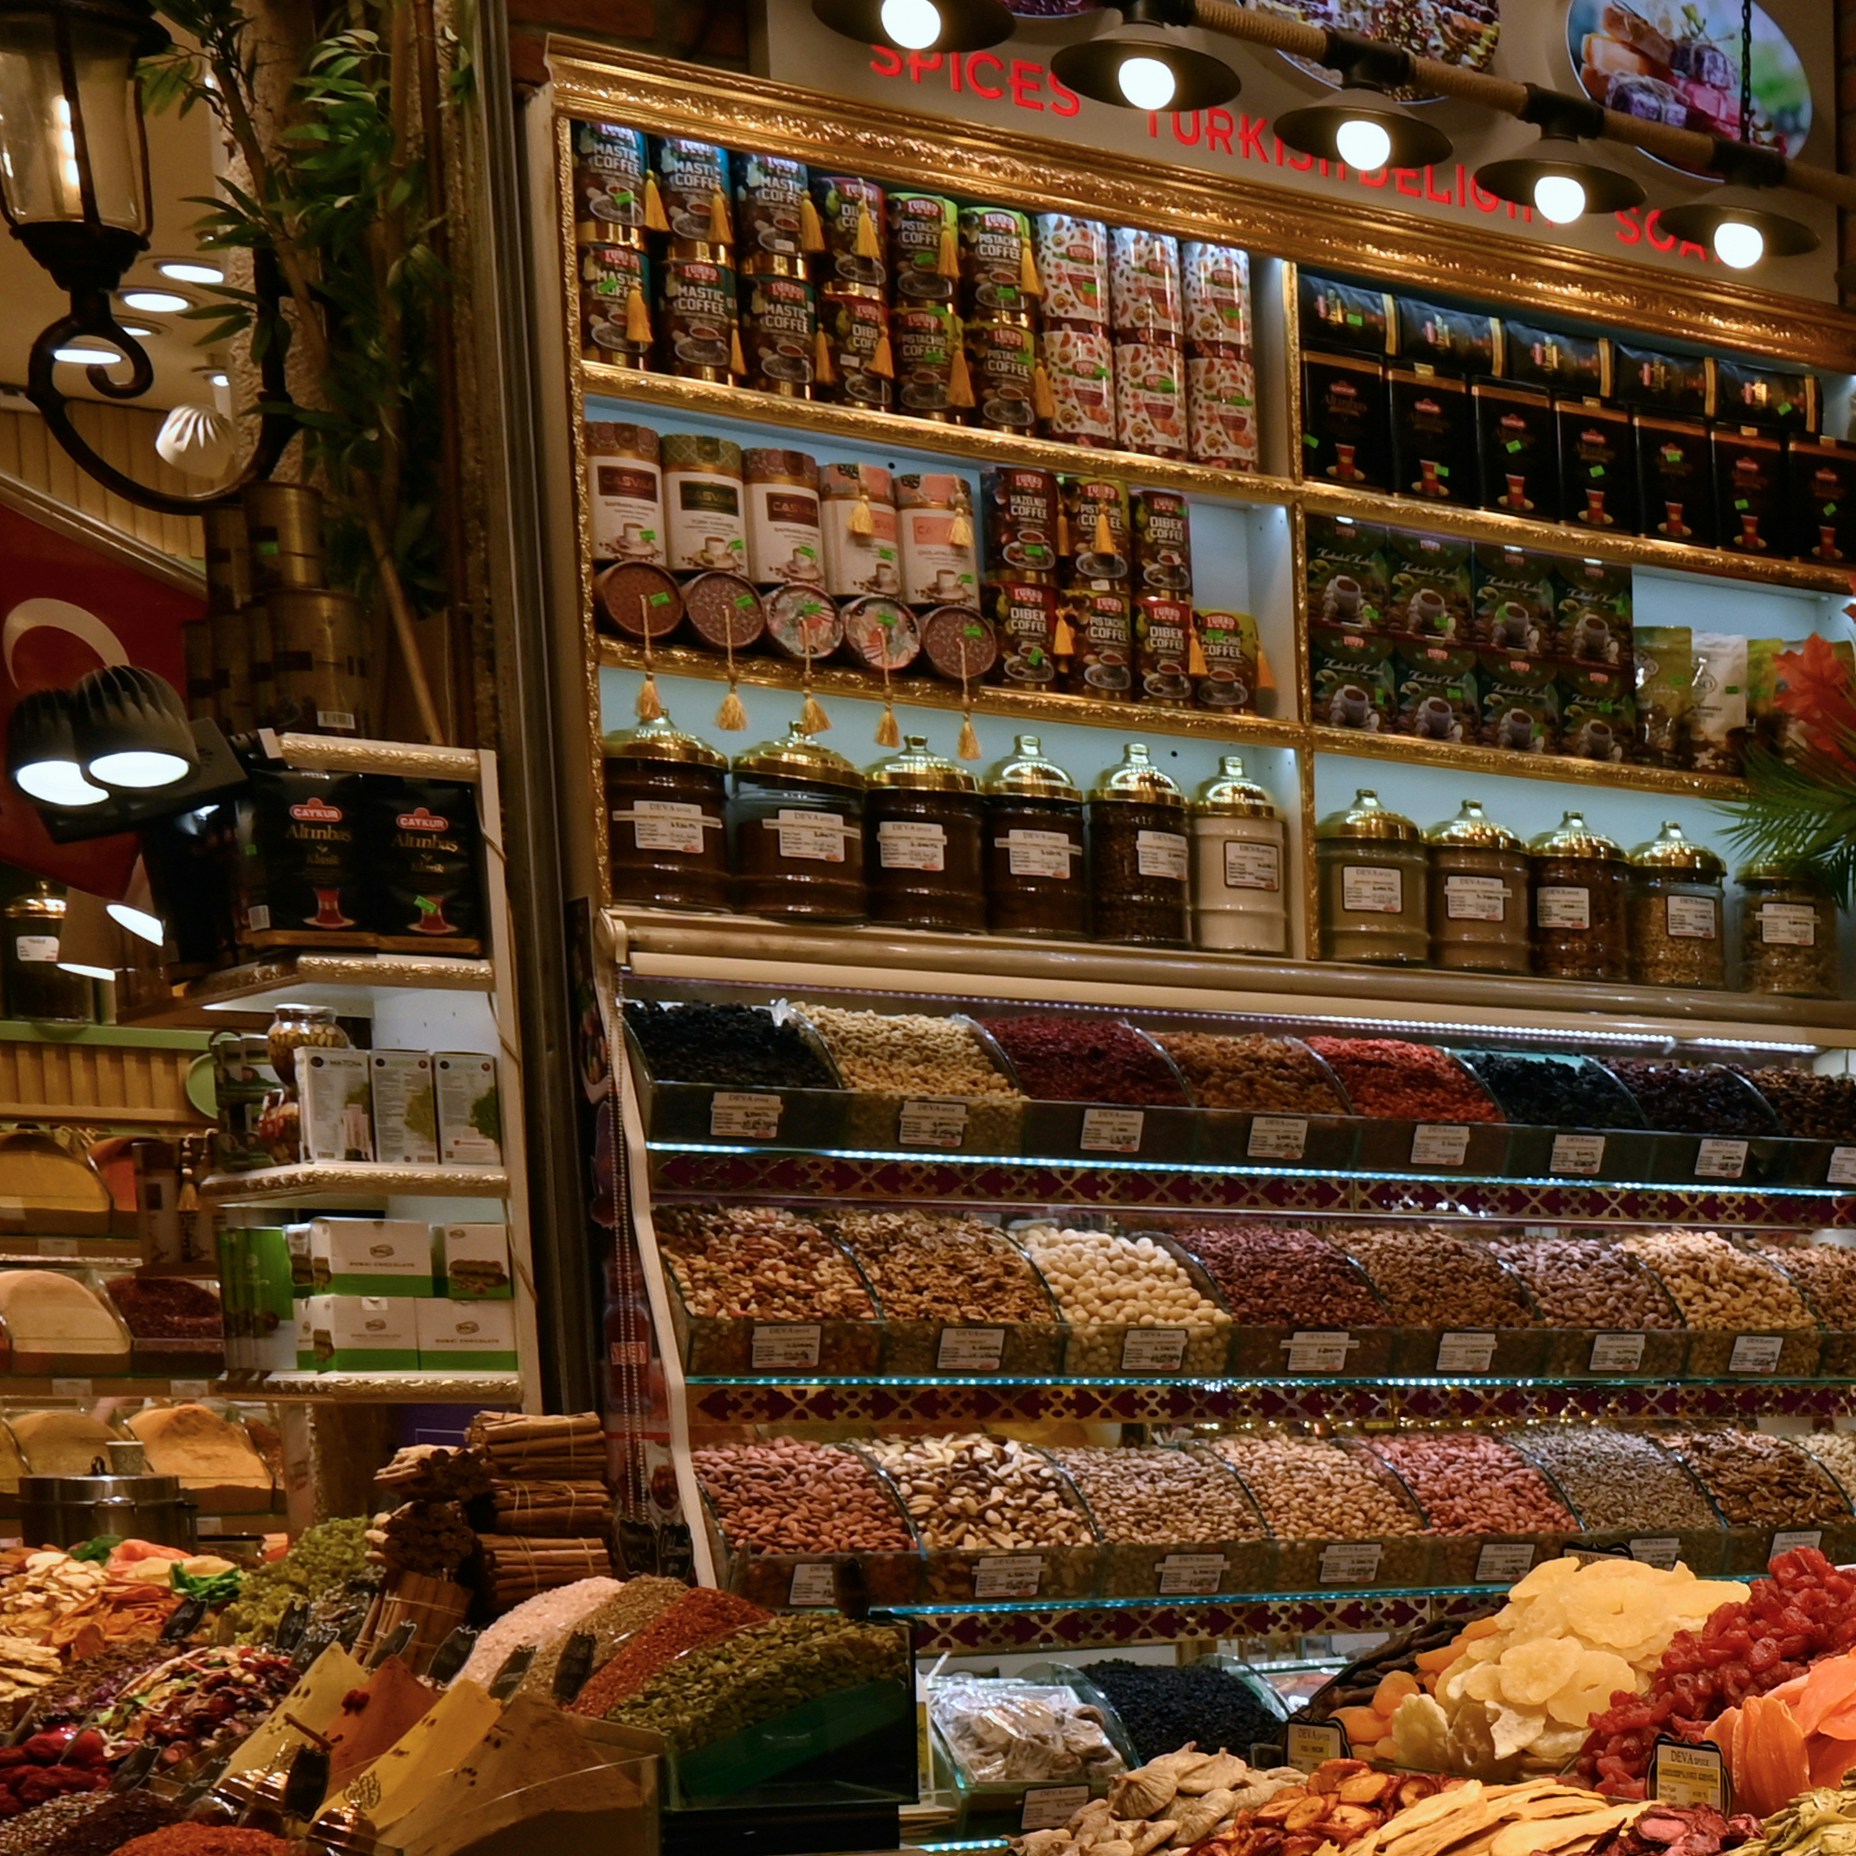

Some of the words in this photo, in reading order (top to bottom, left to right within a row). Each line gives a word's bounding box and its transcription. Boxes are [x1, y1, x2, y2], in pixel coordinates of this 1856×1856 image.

[869, 44, 1081, 117] SPICES
[593, 154, 640, 175] COFFEE
[979, 244, 1021, 261] COFFEE
[676, 285, 724, 304] MASTIC
[677, 297, 725, 316] COFFEE
[987, 361, 1029, 377] COFFEE
[1011, 504, 1048, 520] COFFEE
[1150, 516, 1184, 530] DIBEK
[1150, 526, 1184, 542] COFFEE
[1010, 607, 1046, 623] DIBEK
[1010, 618, 1047, 634] COFFEE
[1089, 626, 1128, 642] COFFEE
[1149, 625, 1184, 640] DIBEK
[1149, 636, 1185, 651] COFFEE
[1202, 642, 1241, 658] COFFEE
